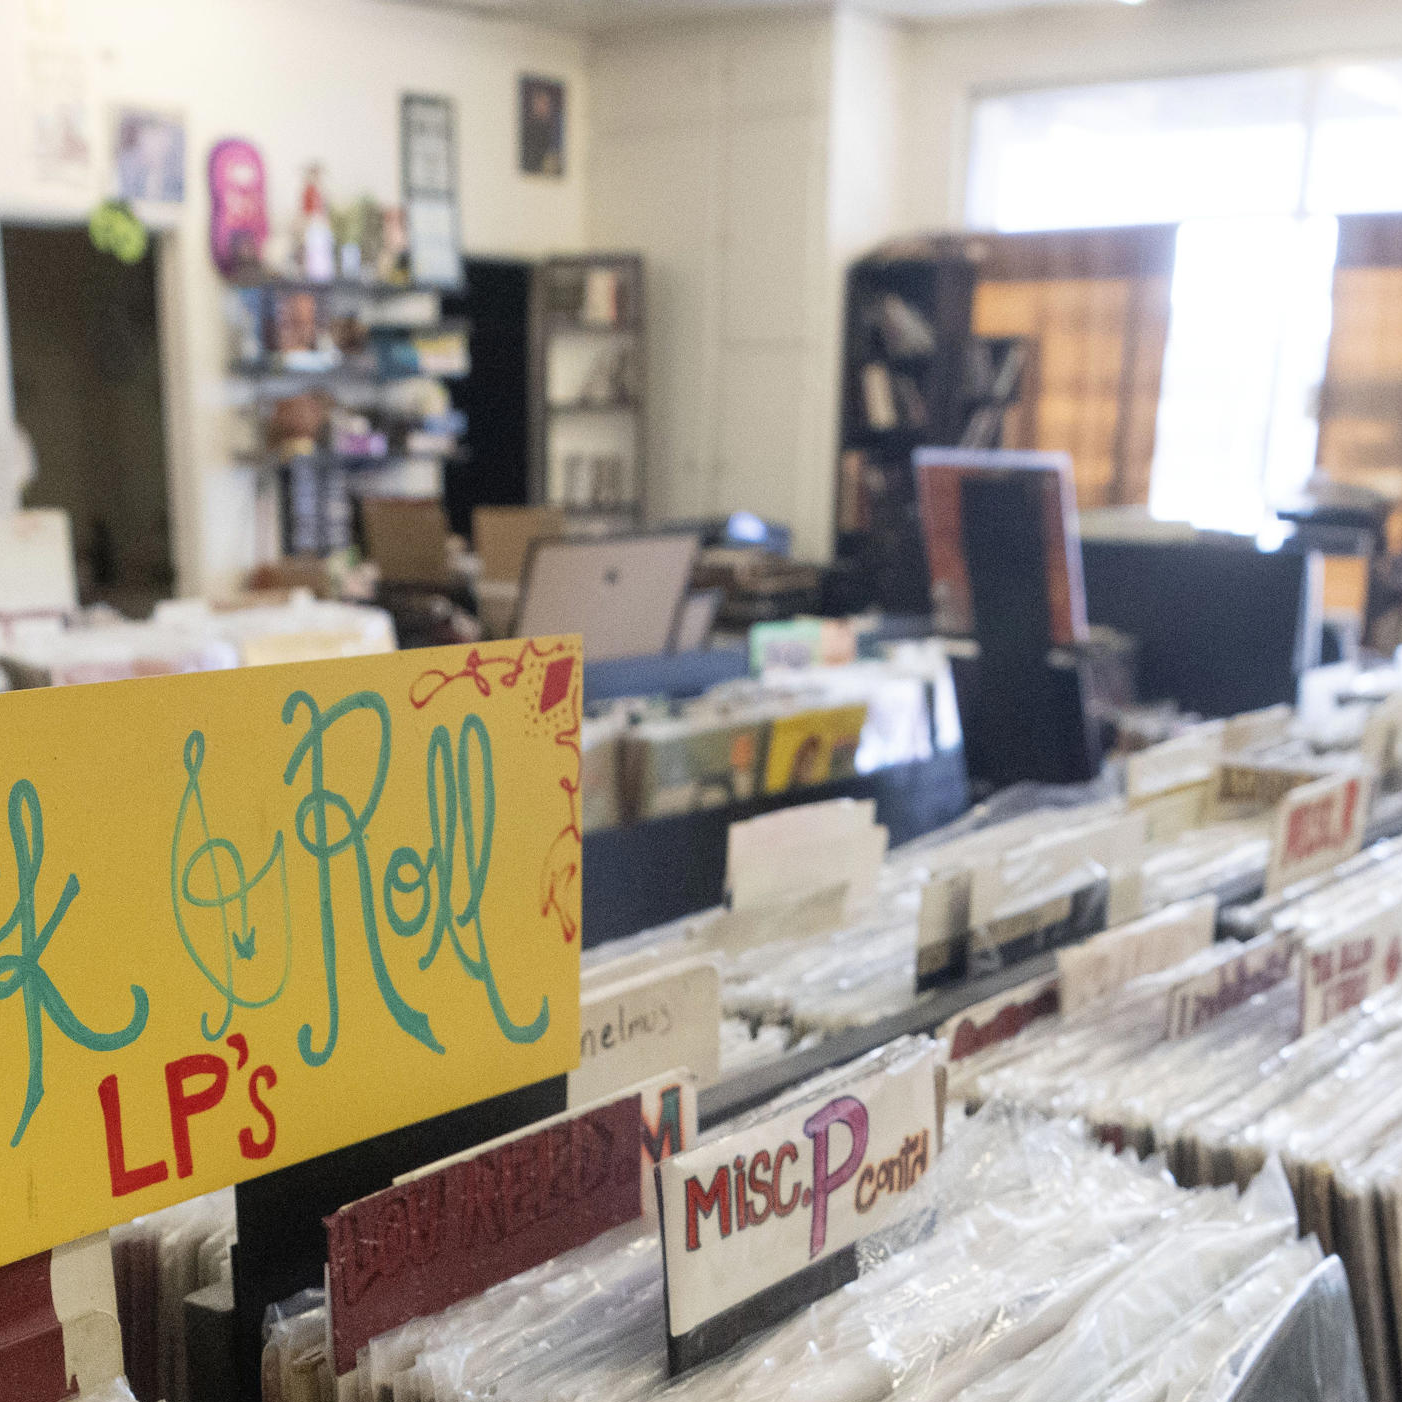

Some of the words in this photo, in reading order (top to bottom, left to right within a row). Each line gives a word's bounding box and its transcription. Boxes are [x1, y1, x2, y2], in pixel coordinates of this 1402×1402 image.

[282, 690, 548, 1067] Roll
[99, 1032, 279, 1198] LP's
[802, 1094, 870, 1261] P
